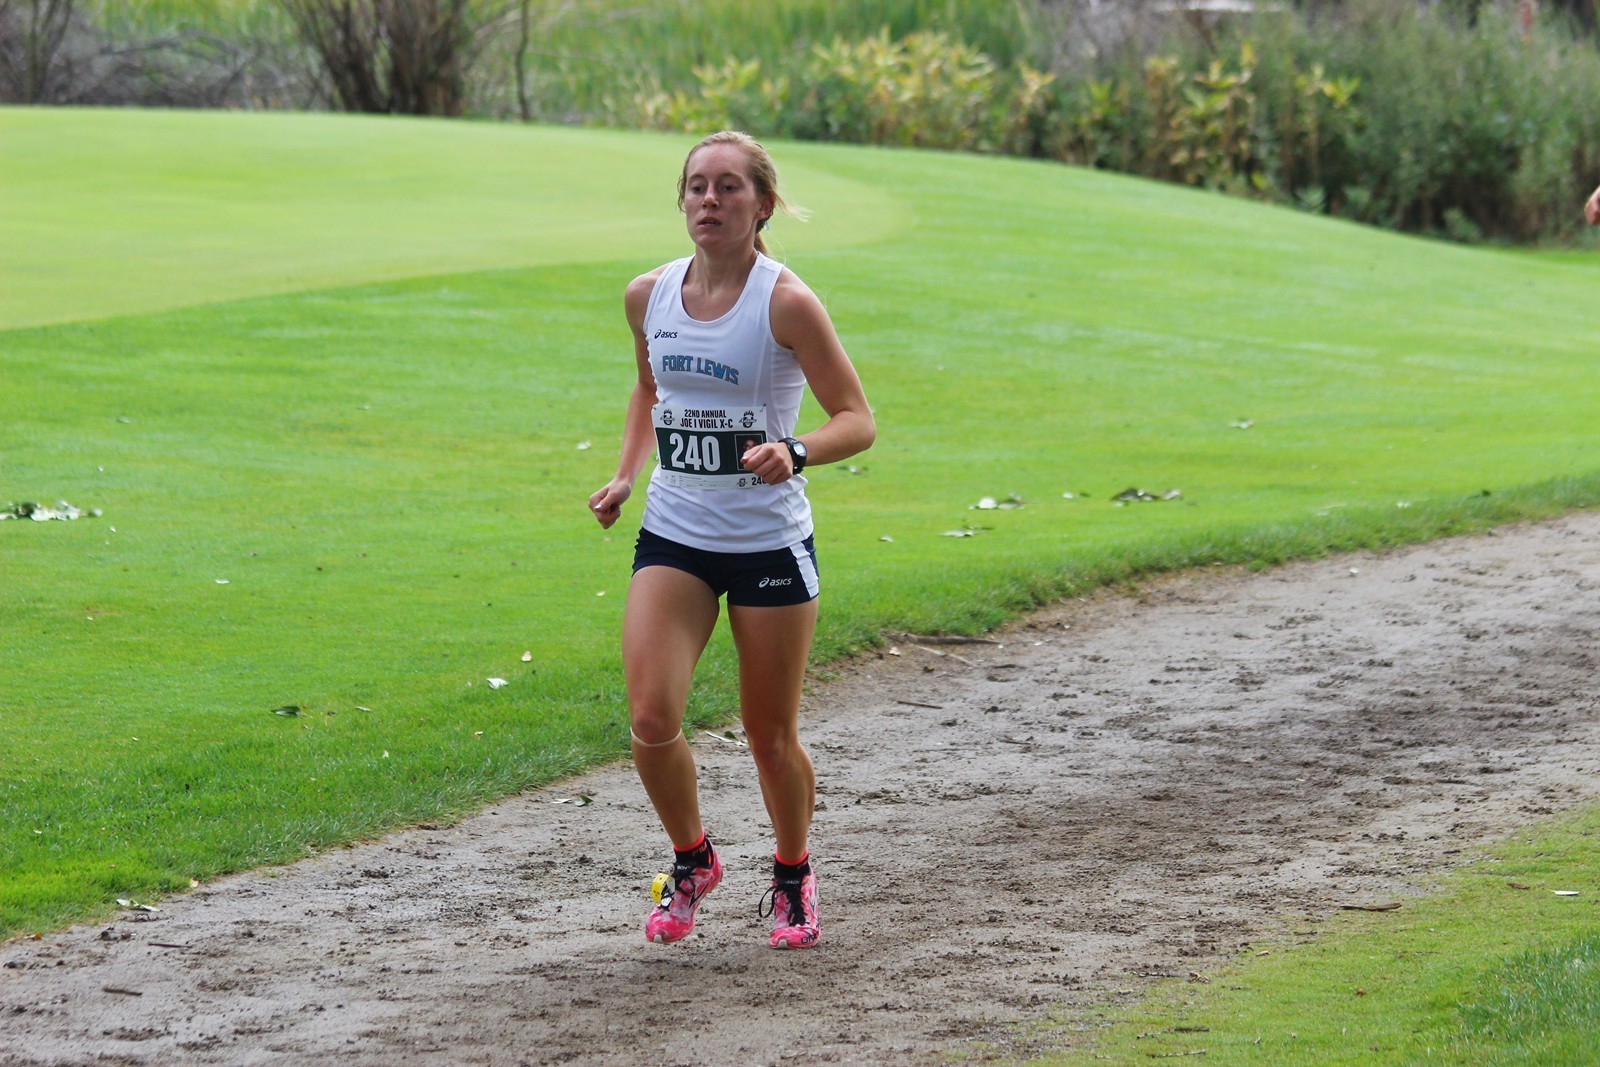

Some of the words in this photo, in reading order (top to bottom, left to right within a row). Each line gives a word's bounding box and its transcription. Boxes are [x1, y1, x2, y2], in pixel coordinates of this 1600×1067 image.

[662, 355, 694, 372] FORT
[696, 357, 739, 385] LEWIS
[684, 409, 700, 418] 22ND
[701, 409, 727, 418] ANNUAL
[680, 418, 693, 428] JOE
[698, 419, 718, 429] VIGIL
[719, 418, 733, 429] X-C
[669, 432, 721, 472] 240
[769, 578, 792, 586] asics
